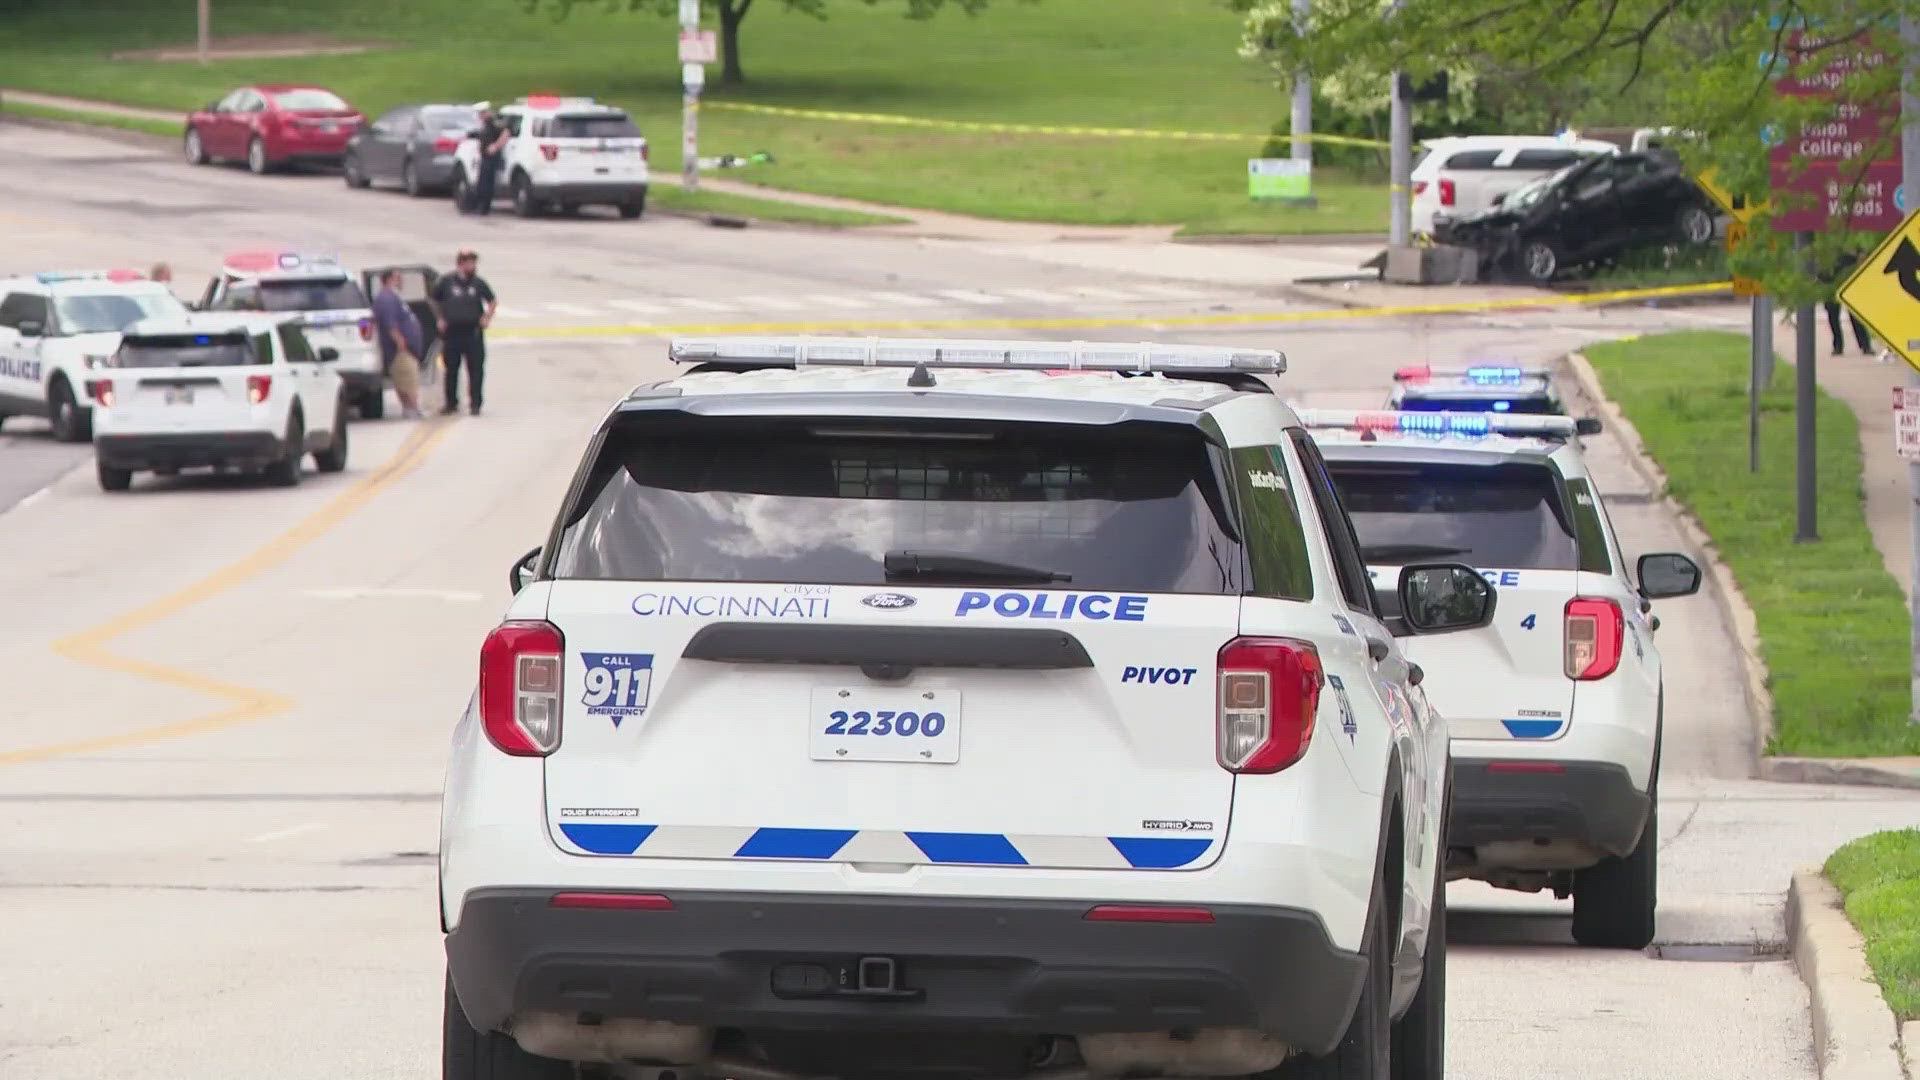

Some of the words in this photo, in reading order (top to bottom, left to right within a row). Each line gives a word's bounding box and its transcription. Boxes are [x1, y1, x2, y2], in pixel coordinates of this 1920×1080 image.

[1800, 139, 1863, 159] College
[1900, 414, 1918, 427] ANY
[783, 584, 814, 595] city
[631, 593, 831, 618] CINCINNATI
[870, 593, 906, 608] Ford
[954, 591, 1149, 622] POLICE
[1520, 613, 1537, 631] 4
[601, 656, 631, 665] CALL
[1121, 666, 1197, 685] PIVOT
[587, 707, 646, 716] EMERGENCY
[824, 710, 946, 738] 22300
[562, 809, 587, 817] POLICE
